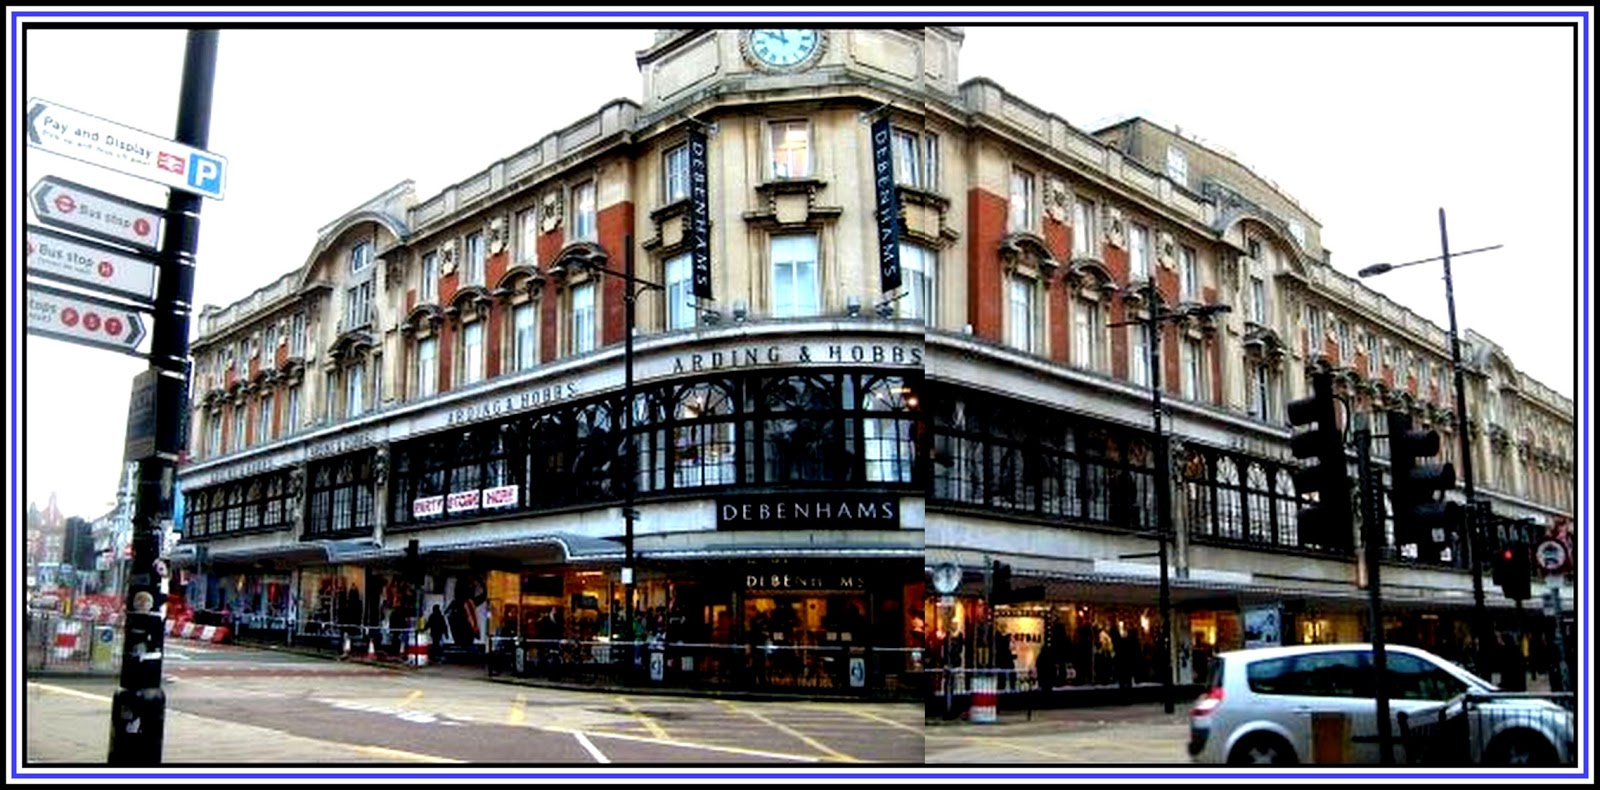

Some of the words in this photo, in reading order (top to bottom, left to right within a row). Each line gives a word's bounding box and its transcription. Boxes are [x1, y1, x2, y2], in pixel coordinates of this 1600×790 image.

[43, 115, 68, 134] Pay
[74, 128, 99, 141] and
[105, 135, 152, 159] Display
[195, 159, 217, 186] P
[80, 203, 102, 220] Bus
[104, 212, 132, 229] stop
[691, 140, 709, 286] DEBENHAMS
[874, 129, 897, 276] DEBENHAMS
[39, 243, 63, 259] Bus
[66, 251, 95, 268] stop
[673, 346, 780, 374] ARDING
[798, 346, 813, 364] &
[828, 345, 923, 365] HOBBS
[722, 502, 894, 521] DEBENHAMS
[746, 574, 864, 588] DEBENHMS
